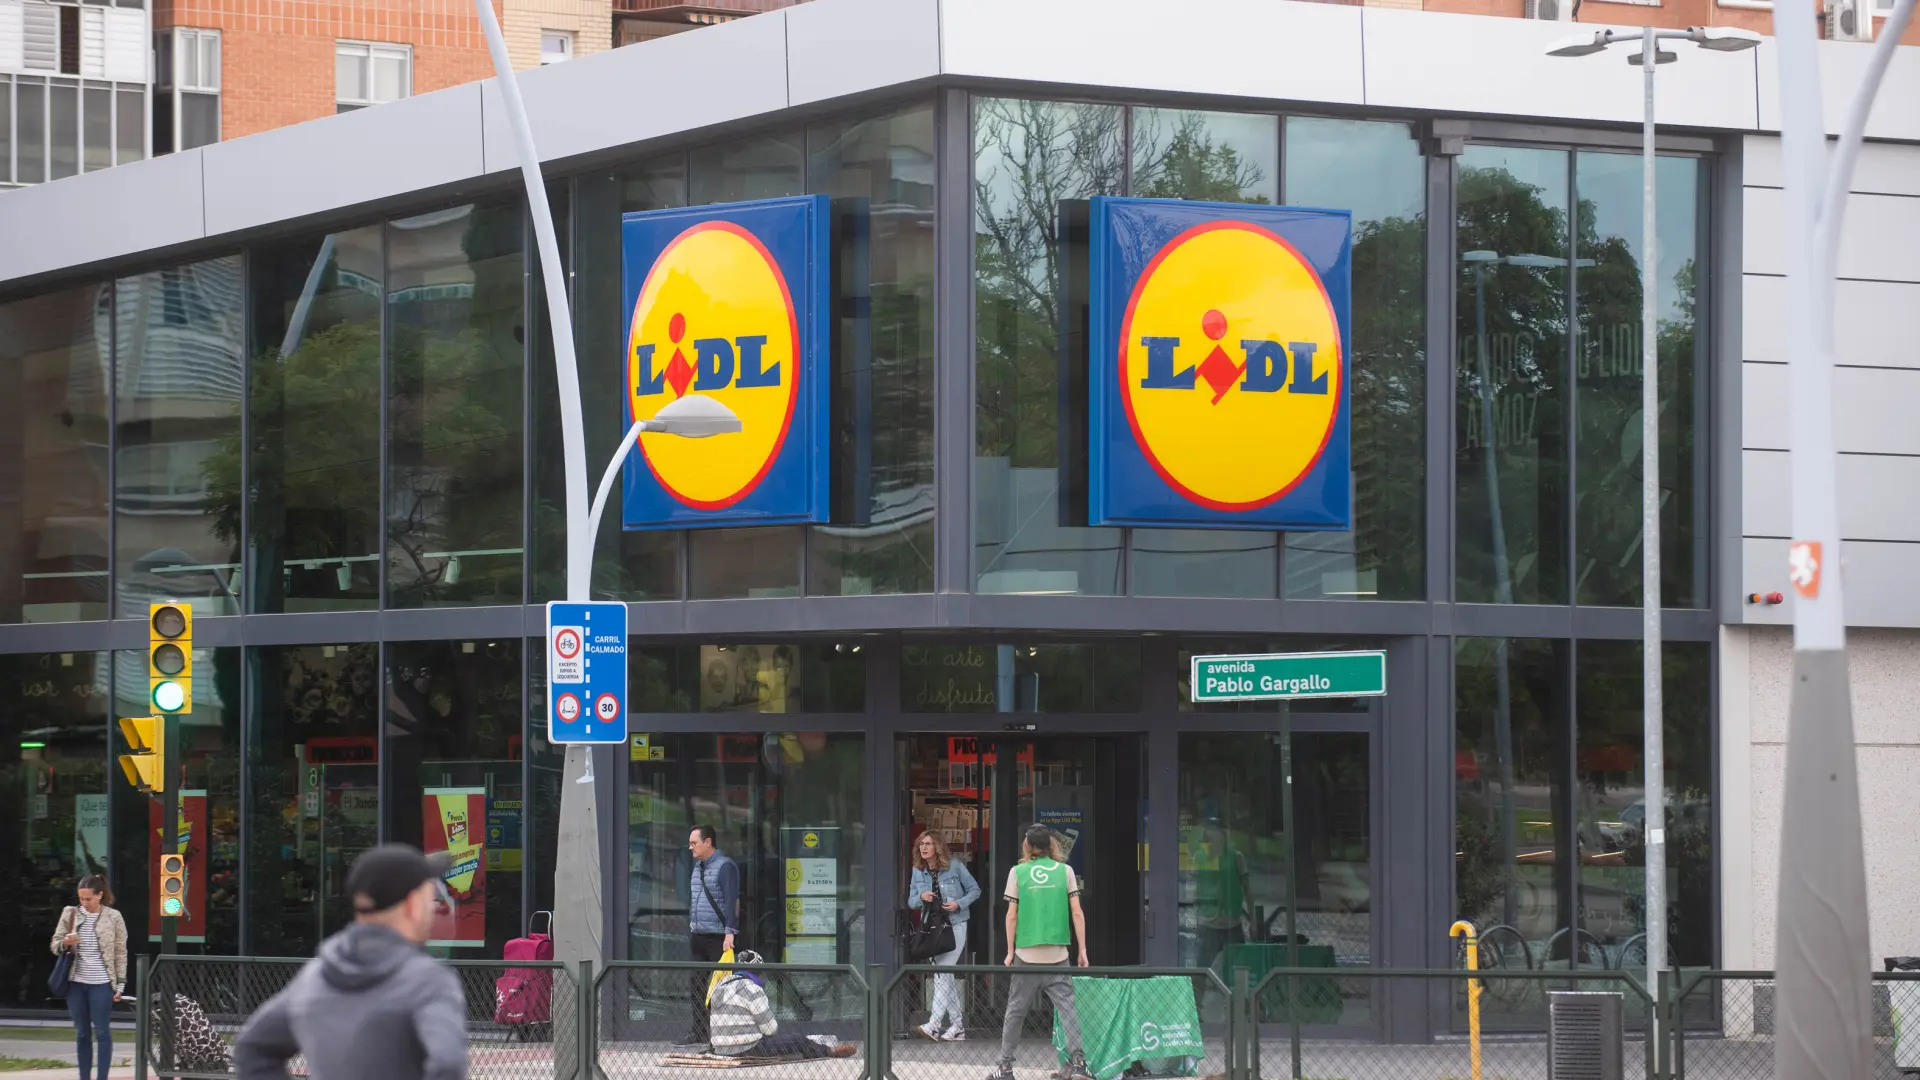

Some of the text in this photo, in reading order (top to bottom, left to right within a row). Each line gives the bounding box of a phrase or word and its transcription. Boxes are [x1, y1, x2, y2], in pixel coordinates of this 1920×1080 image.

[594, 635, 621, 643] CARRIL
[590, 645, 625, 654] CALMADO
[943, 645, 985, 667] arte
[1207, 660, 1255, 674] avenida
[1206, 674, 1331, 694] Pablo Gargallo
[601, 703, 614, 713] 30
